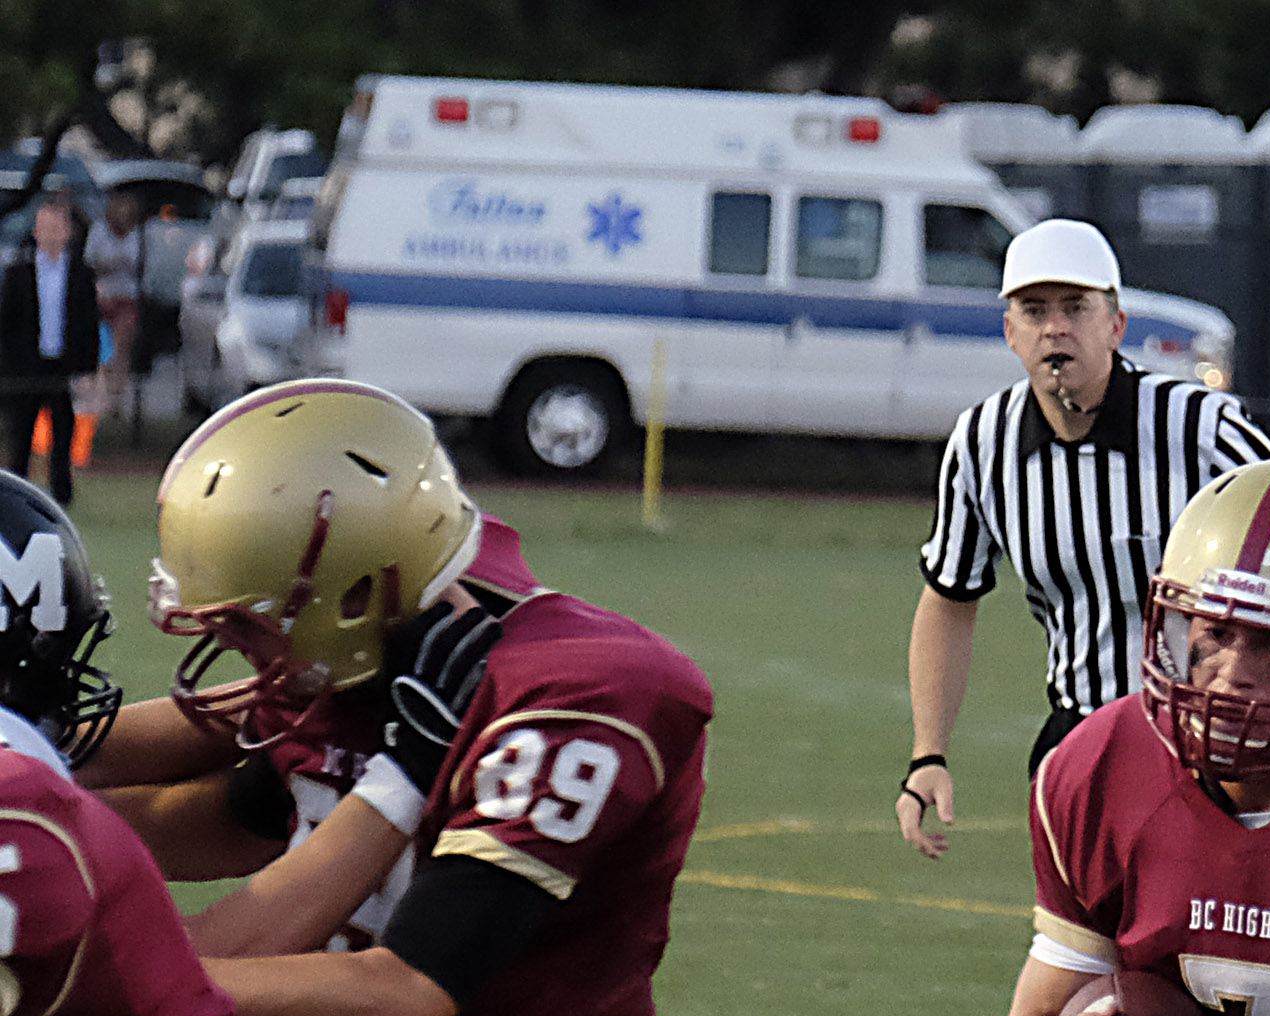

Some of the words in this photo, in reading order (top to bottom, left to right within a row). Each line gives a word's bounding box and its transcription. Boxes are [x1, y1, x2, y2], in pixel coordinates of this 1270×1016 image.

[0, 532, 68, 632] M
[474, 728, 622, 844] 89
[1188, 898, 1217, 931] BC
